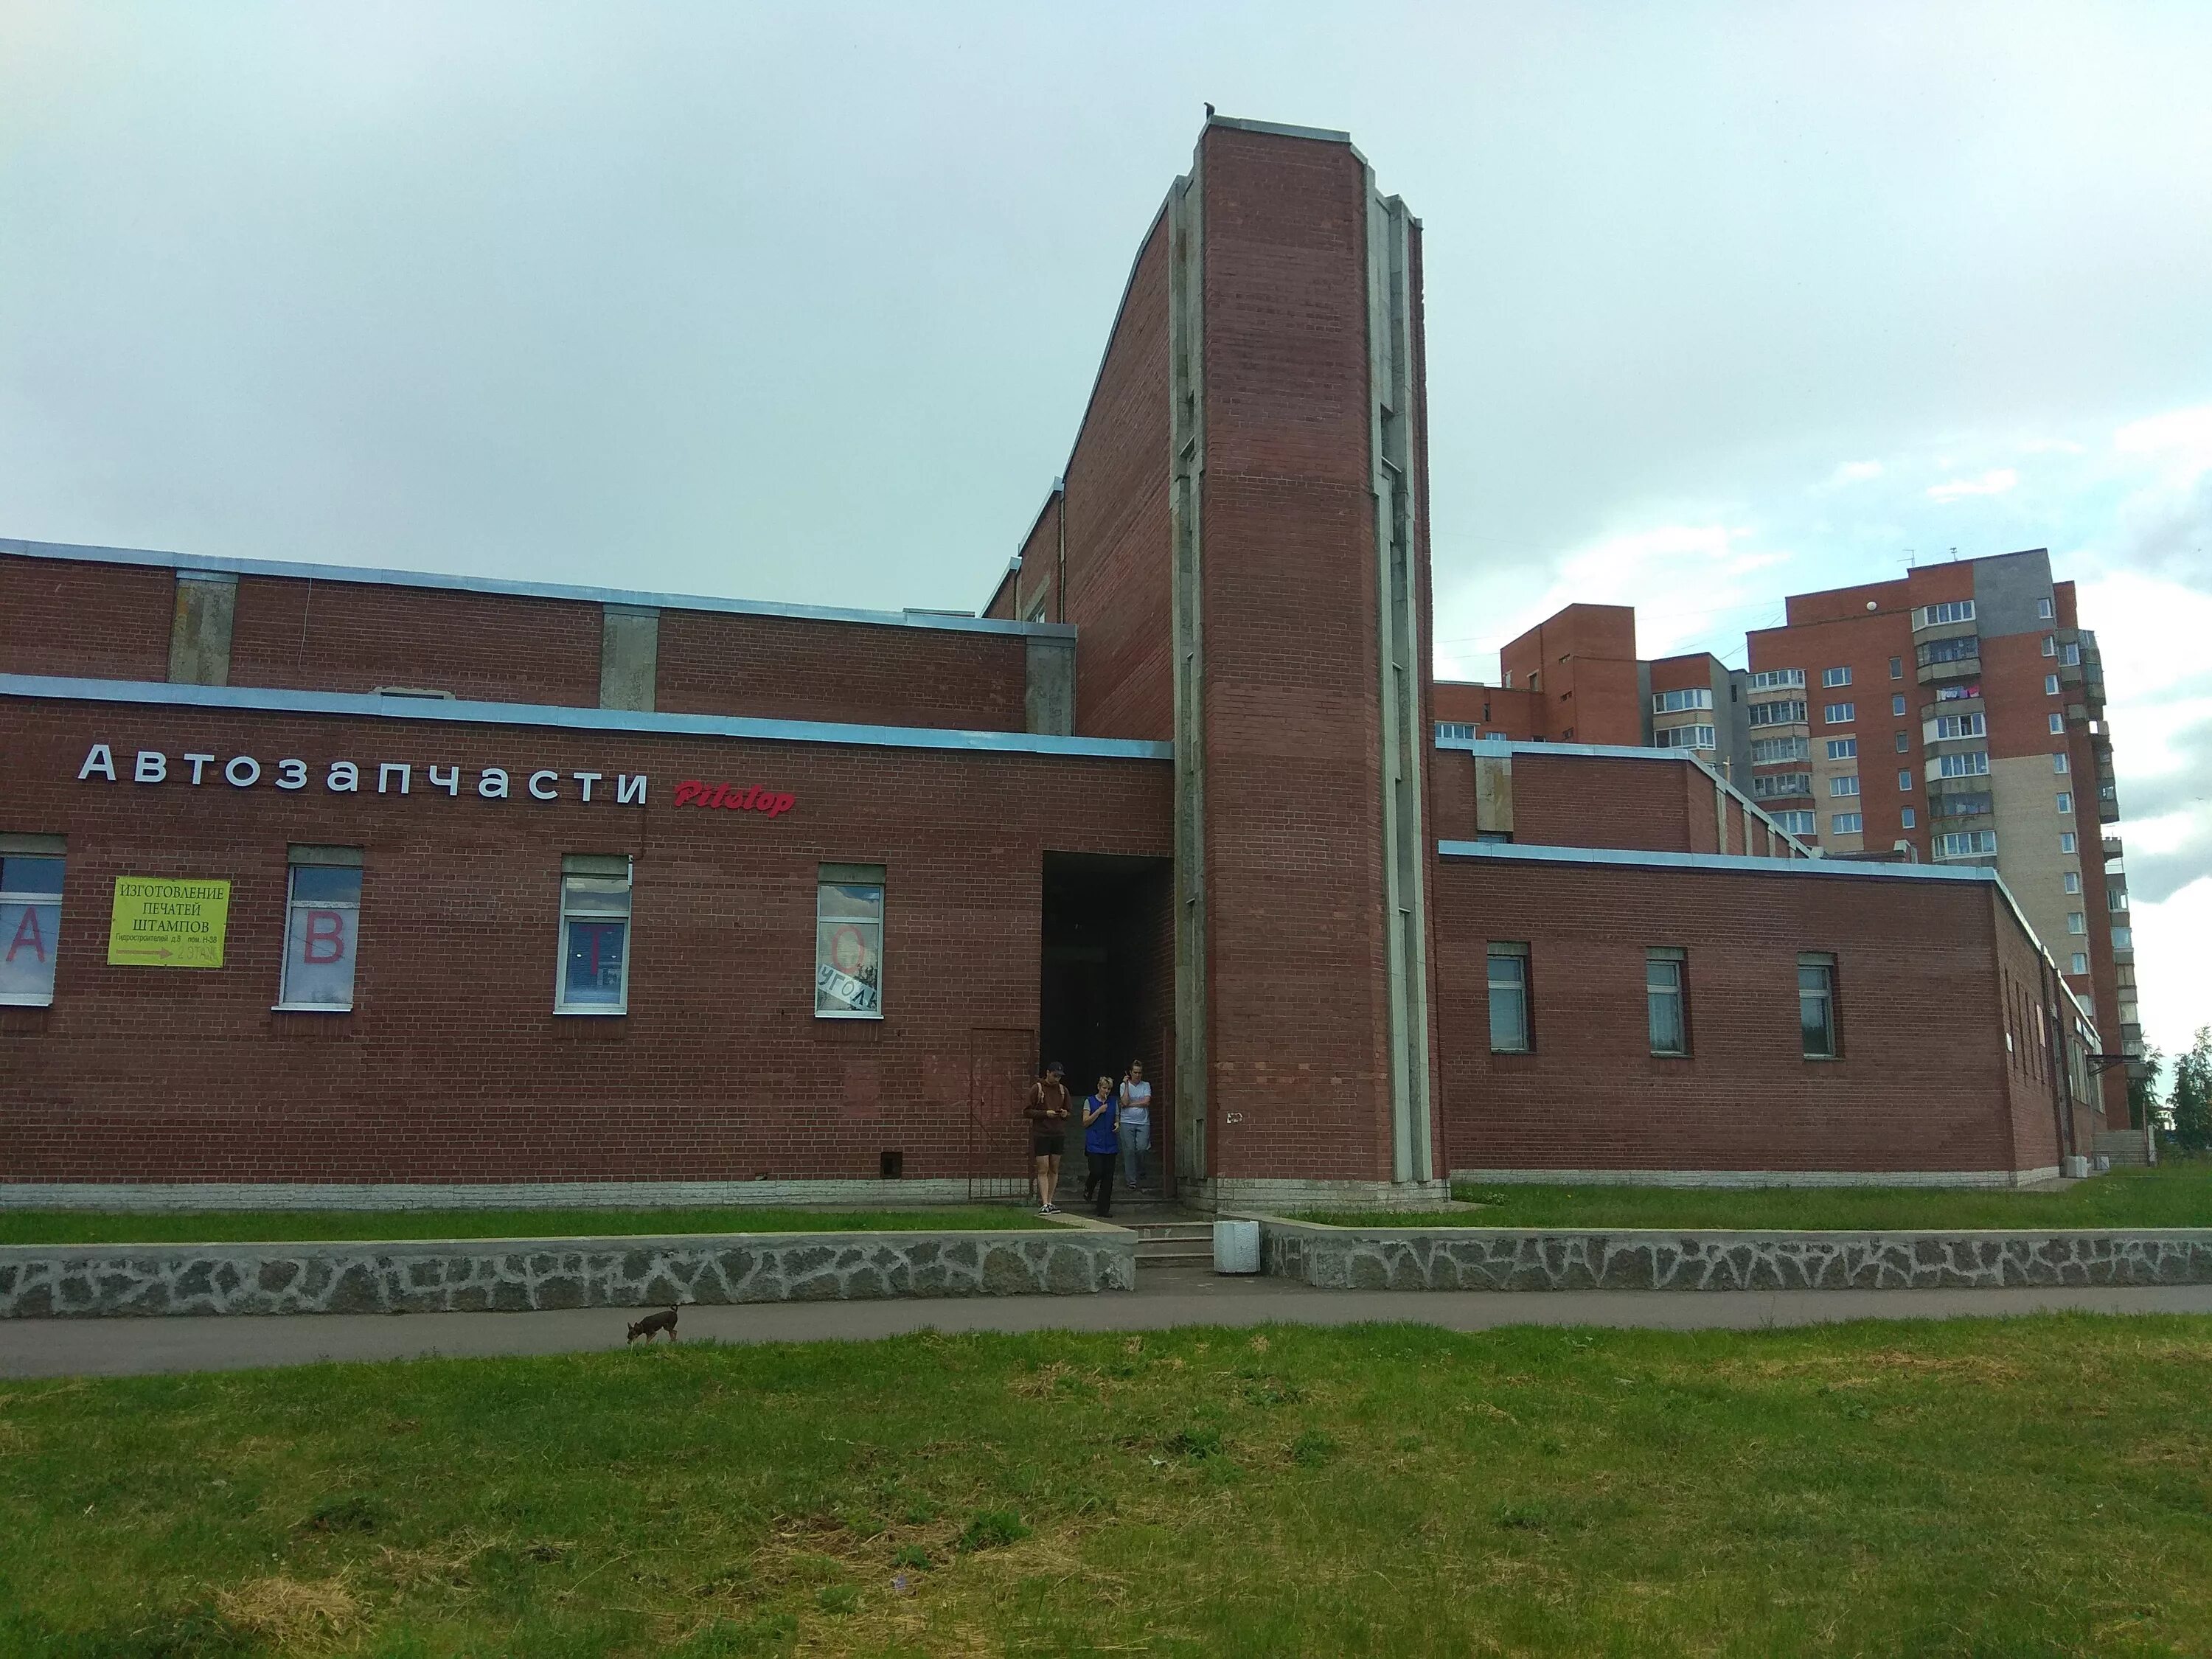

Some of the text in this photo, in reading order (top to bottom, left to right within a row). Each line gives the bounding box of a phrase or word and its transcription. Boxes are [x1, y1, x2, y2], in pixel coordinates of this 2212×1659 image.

[77, 744, 647, 804] Автозапчасти
[119, 884, 224, 900] ИЗГОТОВЛЕНИЕ
[142, 902, 201, 917] ПЕЧАТЕЙ
[133, 919, 209, 933] ШТАМПОВ
[115, 932, 169, 944] Гидростроителей
